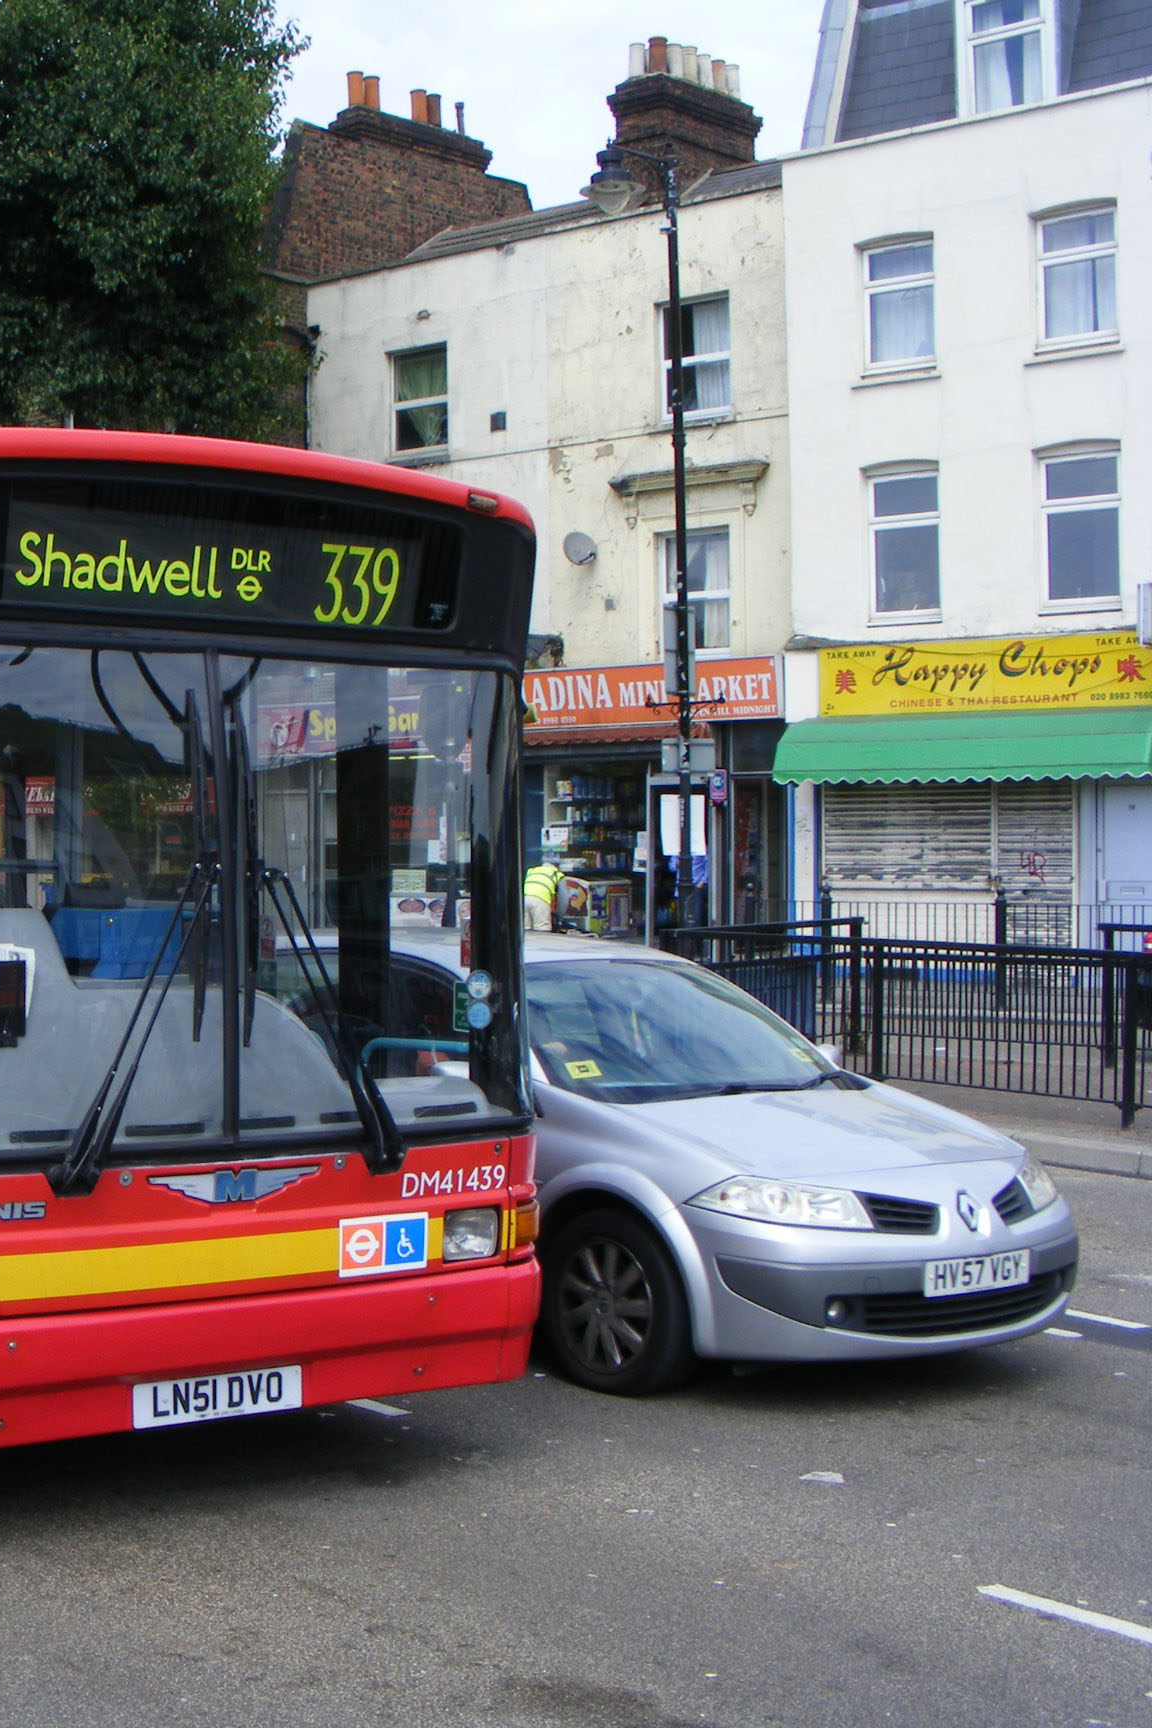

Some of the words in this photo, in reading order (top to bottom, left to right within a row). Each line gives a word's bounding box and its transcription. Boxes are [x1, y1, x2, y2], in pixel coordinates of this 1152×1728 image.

[15, 531, 222, 599] Shadwell
[231, 548, 271, 573] DLR
[314, 543, 399, 625] 339
[826, 651, 850, 660] TAKE
[853, 650, 876, 658] AWAY
[1096, 636, 1121, 646] TAKE
[872, 646, 988, 693] Happy
[999, 641, 1101, 688] Chops
[688, 672, 771, 703] ARKET
[890, 698, 942, 709] CHINESE
[947, 699, 954, 707] &
[960, 696, 988, 706] THAI
[993, 692, 1078, 705] RESTAURANT
[732, 704, 776, 714] MIDNIGHT
[401, 1164, 505, 1198] DM41439
[153, 1378, 218, 1418] LN51
